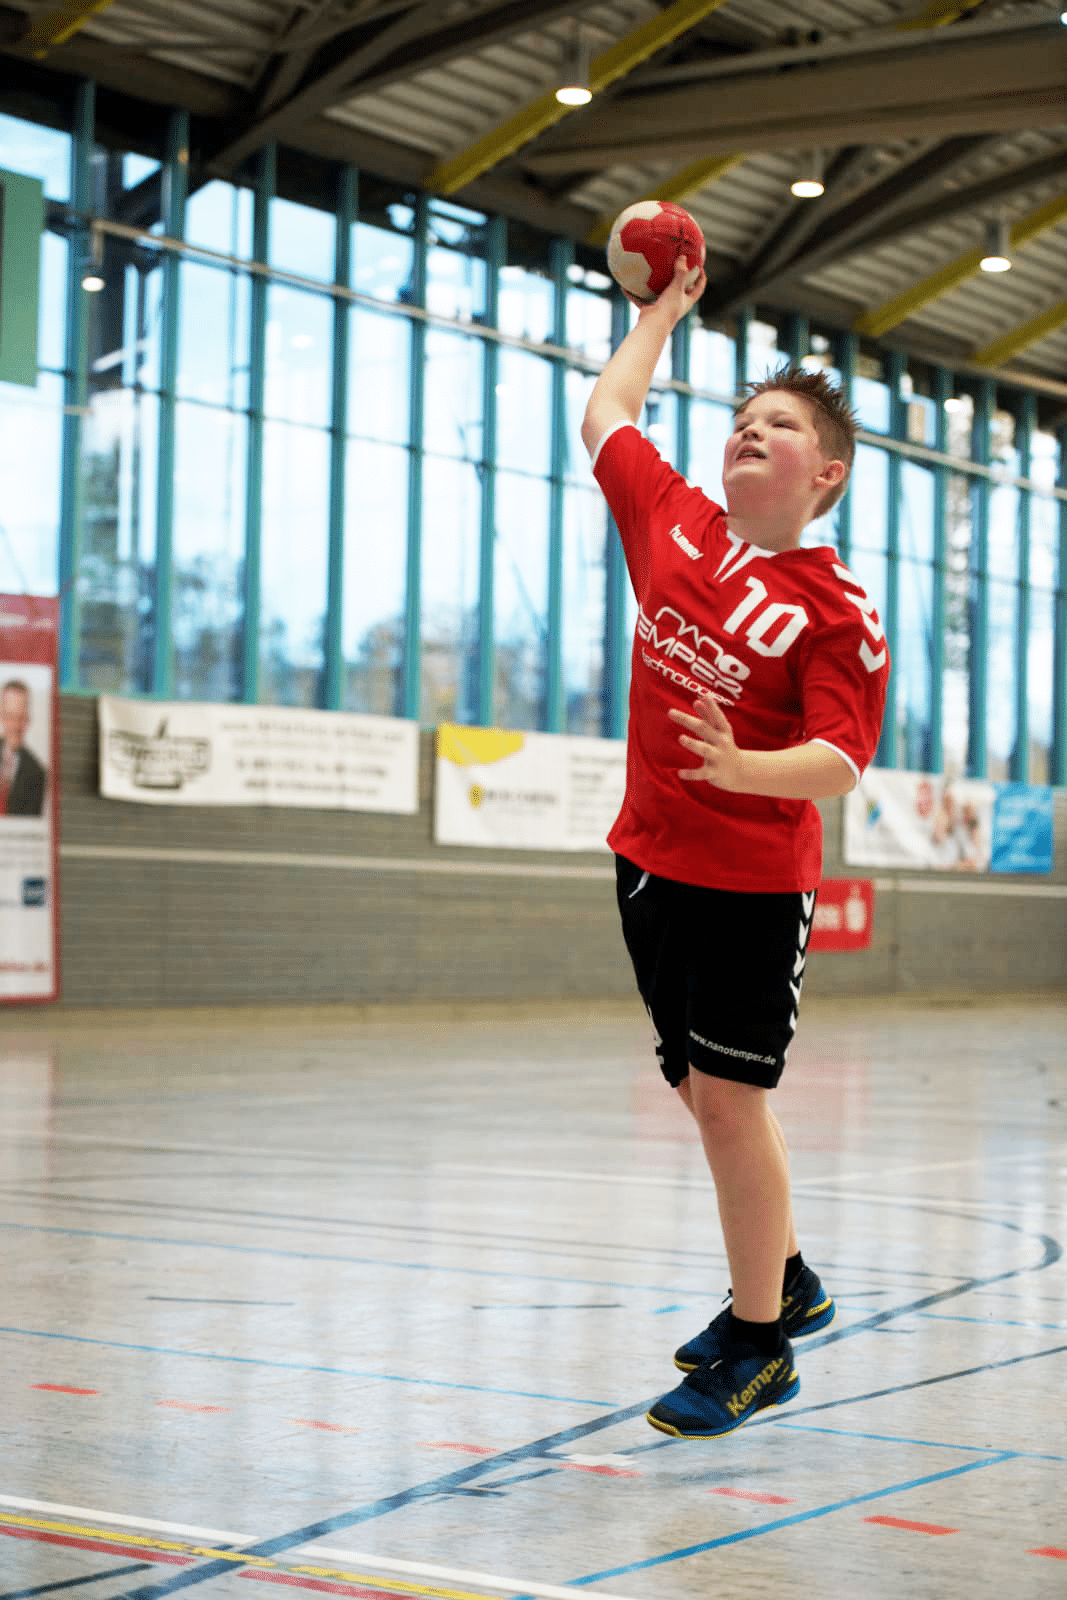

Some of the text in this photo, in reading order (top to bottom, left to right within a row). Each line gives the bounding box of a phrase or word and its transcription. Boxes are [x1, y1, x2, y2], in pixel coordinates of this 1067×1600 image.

[668, 523, 704, 561] hummel
[722, 575, 809, 658] 10
[638, 602, 743, 700] EMPER
[689, 1029, 777, 1066] www.nanotemper.de
